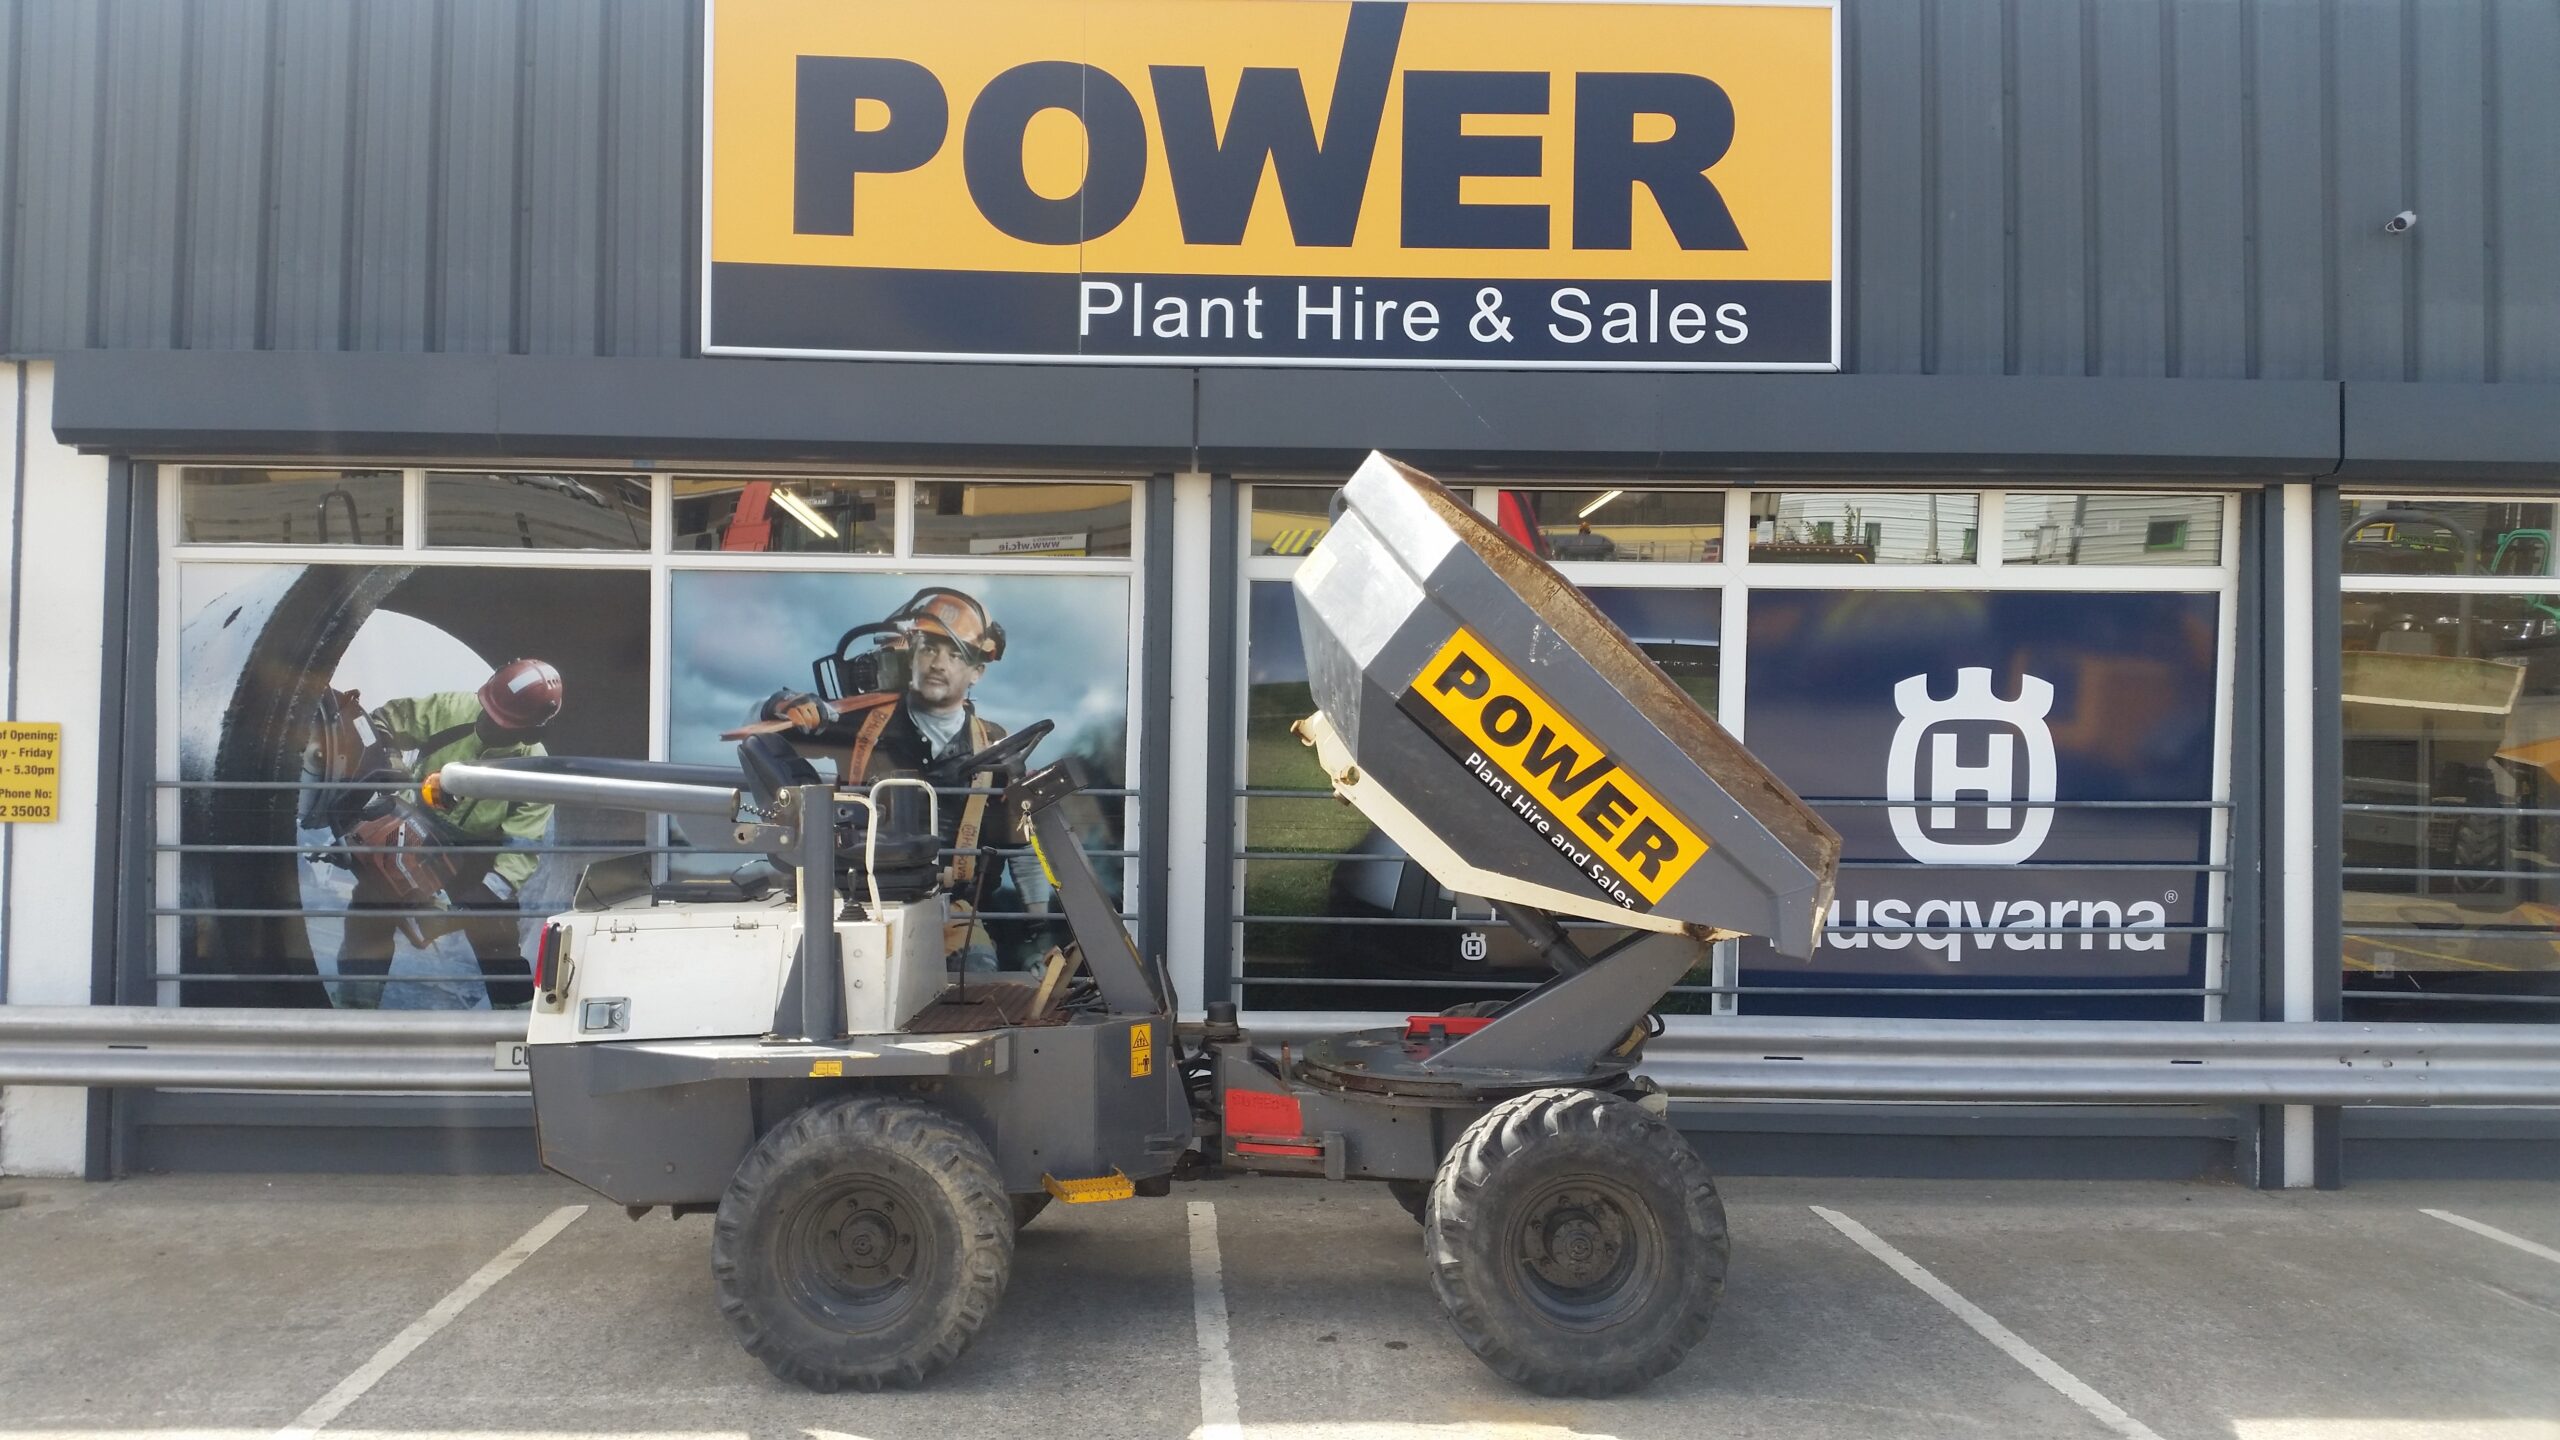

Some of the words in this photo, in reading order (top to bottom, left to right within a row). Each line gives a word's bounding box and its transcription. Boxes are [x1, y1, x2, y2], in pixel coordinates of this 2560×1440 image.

[793, 2, 1748, 252] POWER
[1080, 281, 1264, 342] Plant
[1296, 285, 1441, 344] Hire
[1469, 287, 1515, 345] &
[1547, 287, 1749, 347] Sales
[10, 730, 58, 742] Opening:
[19, 747, 53, 759] Friday
[14, 765, 55, 776] 5.30pm
[1433, 651, 1680, 883] POWER
[34, 789, 52, 799] No:
[11, 805, 50, 817] 35003
[1464, 752, 1515, 800] Plant
[1511, 793, 1550, 835] Hire
[1550, 832, 1588, 868] and
[1587, 863, 1635, 910] Sales
